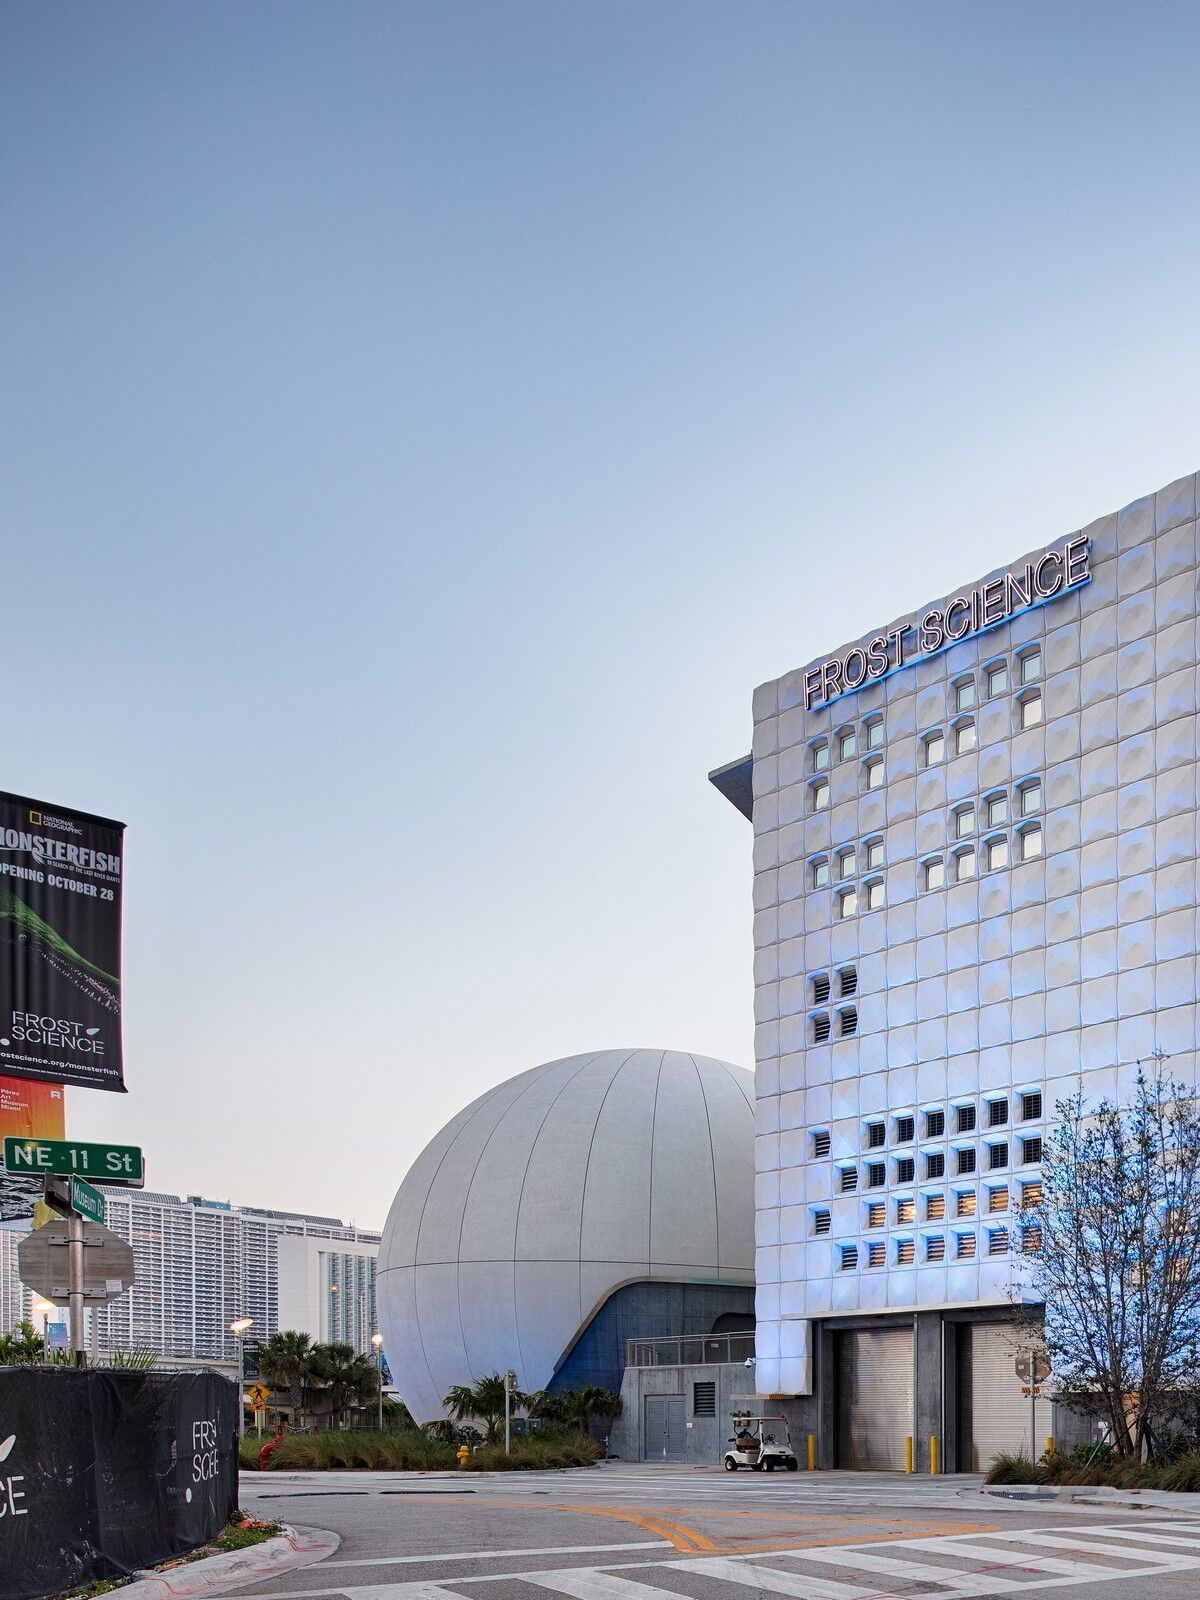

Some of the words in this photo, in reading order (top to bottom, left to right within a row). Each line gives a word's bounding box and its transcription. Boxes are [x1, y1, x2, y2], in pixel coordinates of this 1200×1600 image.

[803, 624, 911, 711] FROST
[921, 534, 1090, 653] SCIENCE
[42, 821, 83, 835] GEOGRAPHIC
[43, 815, 74, 827] NATIONAL
[47, 874, 97, 897] OCTOBER
[100, 887, 114, 901] 28
[12, 1010, 84, 1036] FROST
[12, 1025, 105, 1055] SCIENCE
[1, 1099, 28, 1108] Museum
[1, 1103, 21, 1111] Miami
[14, 1145, 53, 1167] NE
[69, 1149, 88, 1169] 11
[106, 1152, 133, 1172] St
[73, 1182, 97, 1214] Museum
